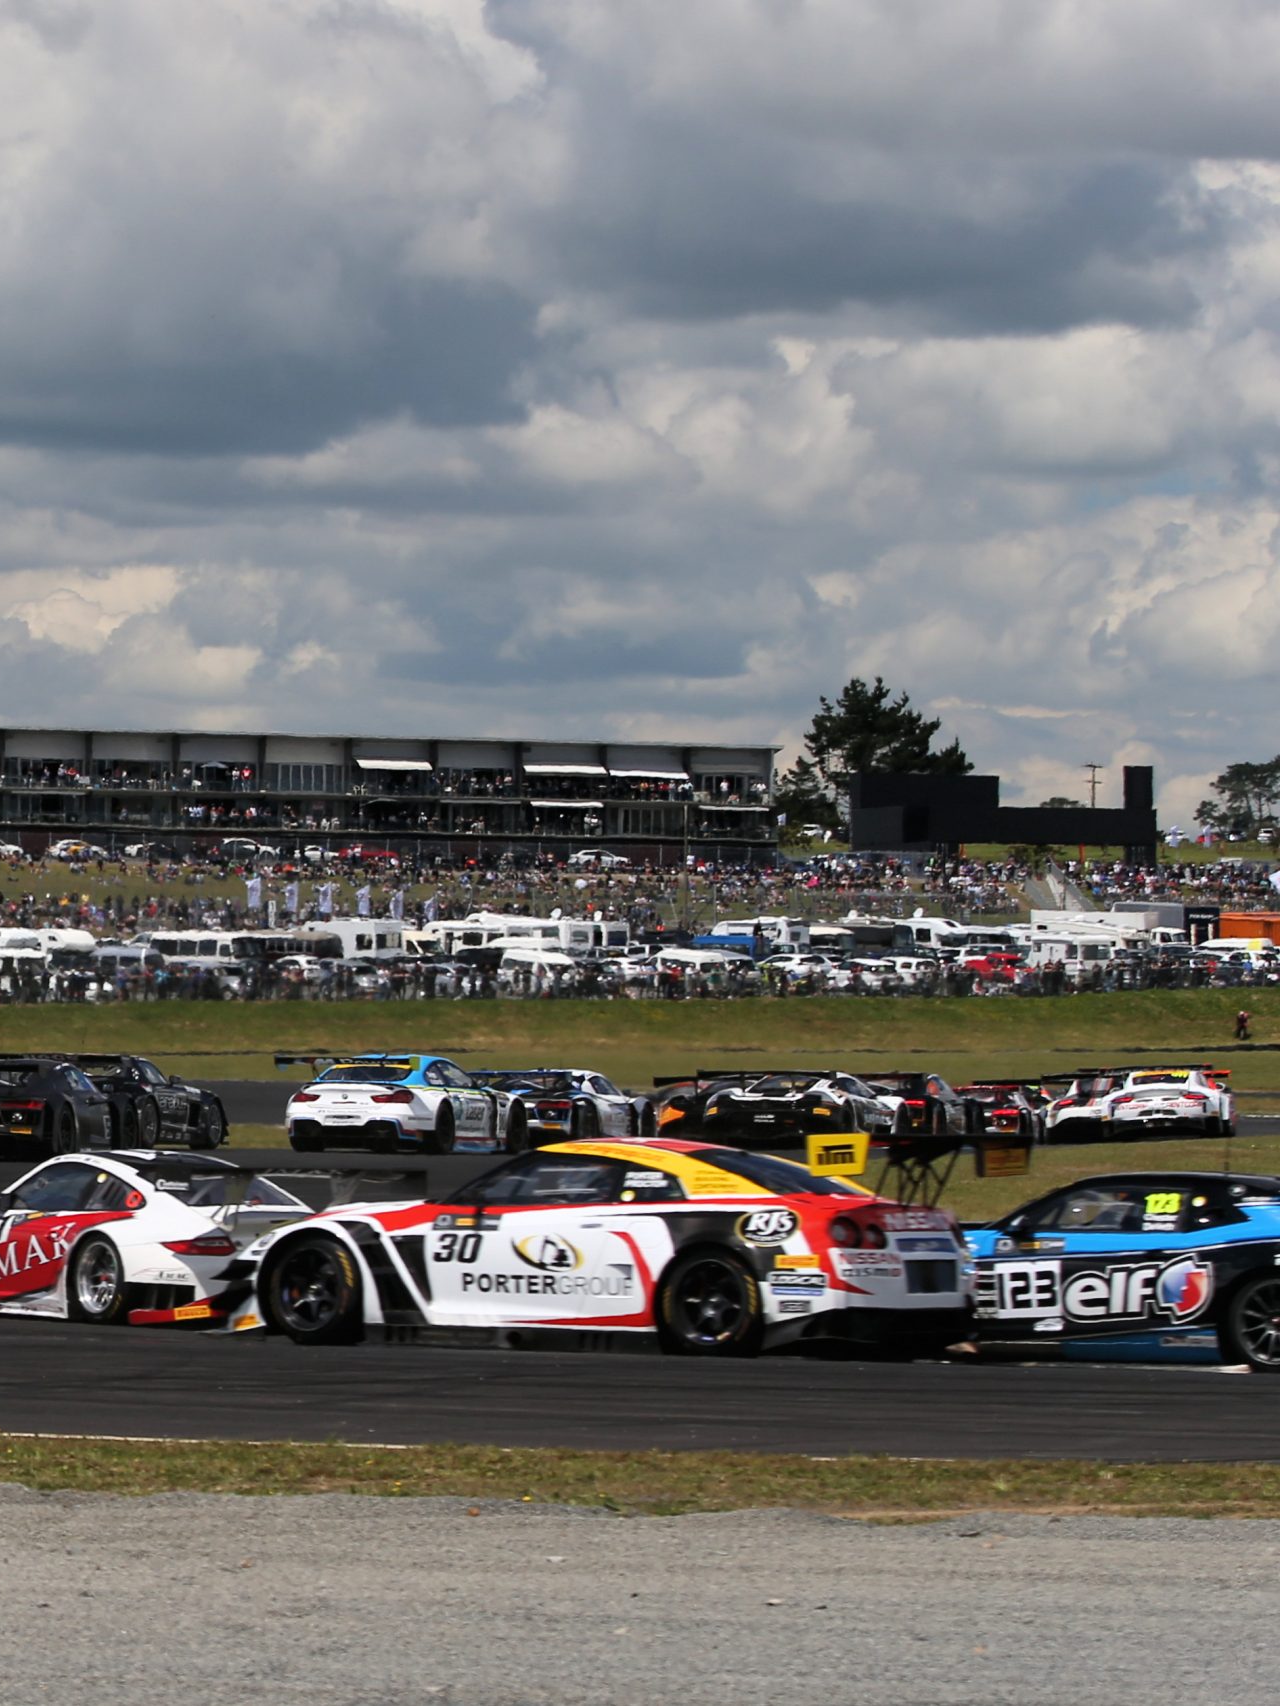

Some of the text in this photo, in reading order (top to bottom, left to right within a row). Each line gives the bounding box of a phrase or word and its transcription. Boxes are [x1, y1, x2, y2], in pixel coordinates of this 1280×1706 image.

[433, 1233, 483, 1264] 30
[839, 1253, 901, 1265] NISSAN
[461, 1273, 633, 1296] PORTERGROUP
[998, 1271, 1059, 1310] 123
[1065, 1268, 1159, 1316] elf
